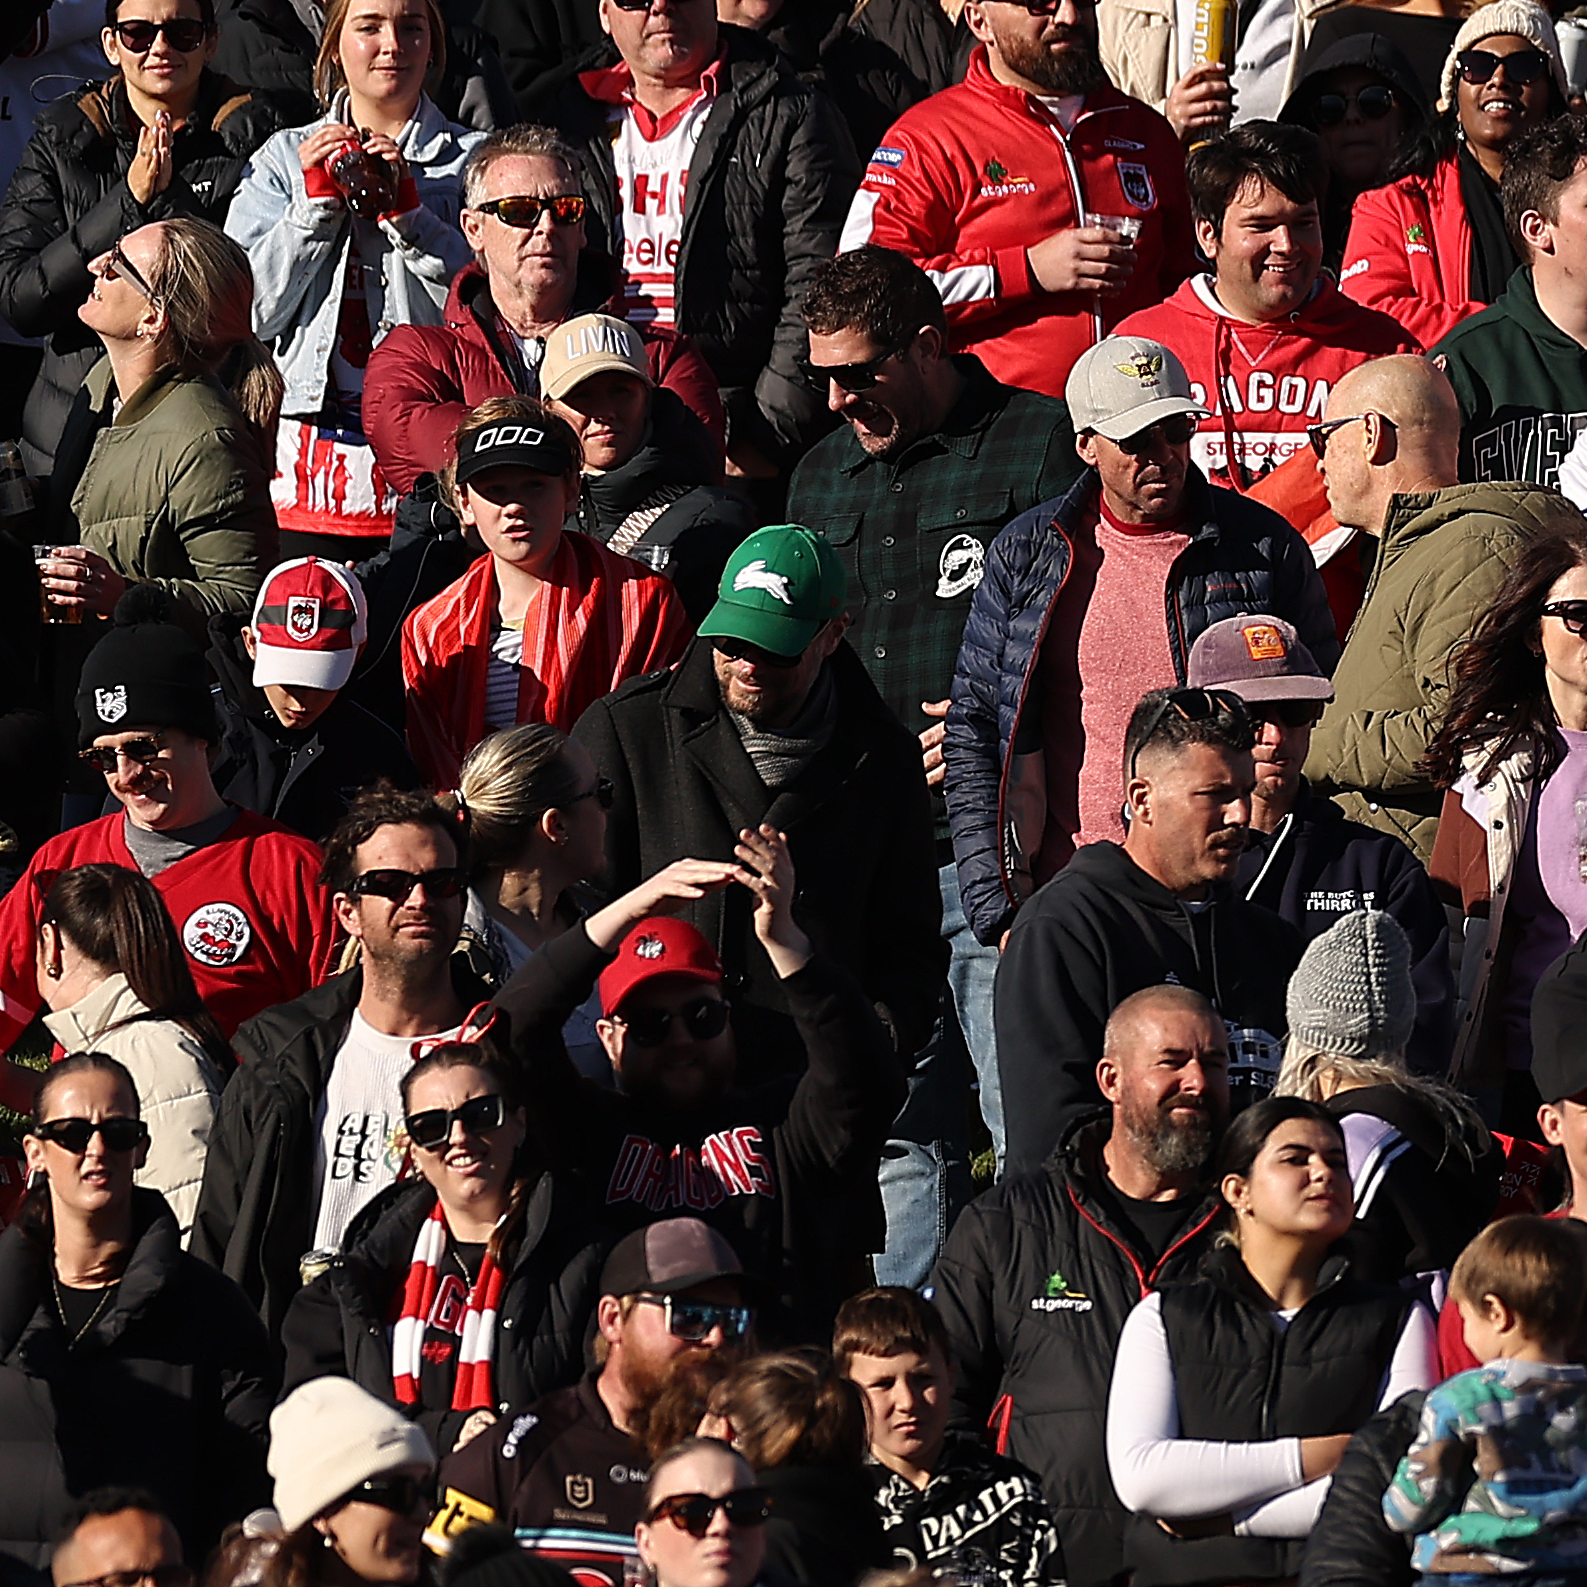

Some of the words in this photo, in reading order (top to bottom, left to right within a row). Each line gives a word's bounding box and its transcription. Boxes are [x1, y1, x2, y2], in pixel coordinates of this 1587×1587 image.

[567, 323, 631, 358] LIVIN
[1305, 899, 1373, 911] THIRRL
[1326, 890, 1374, 899] BUTCRS
[606, 1126, 775, 1211] DRAGONS
